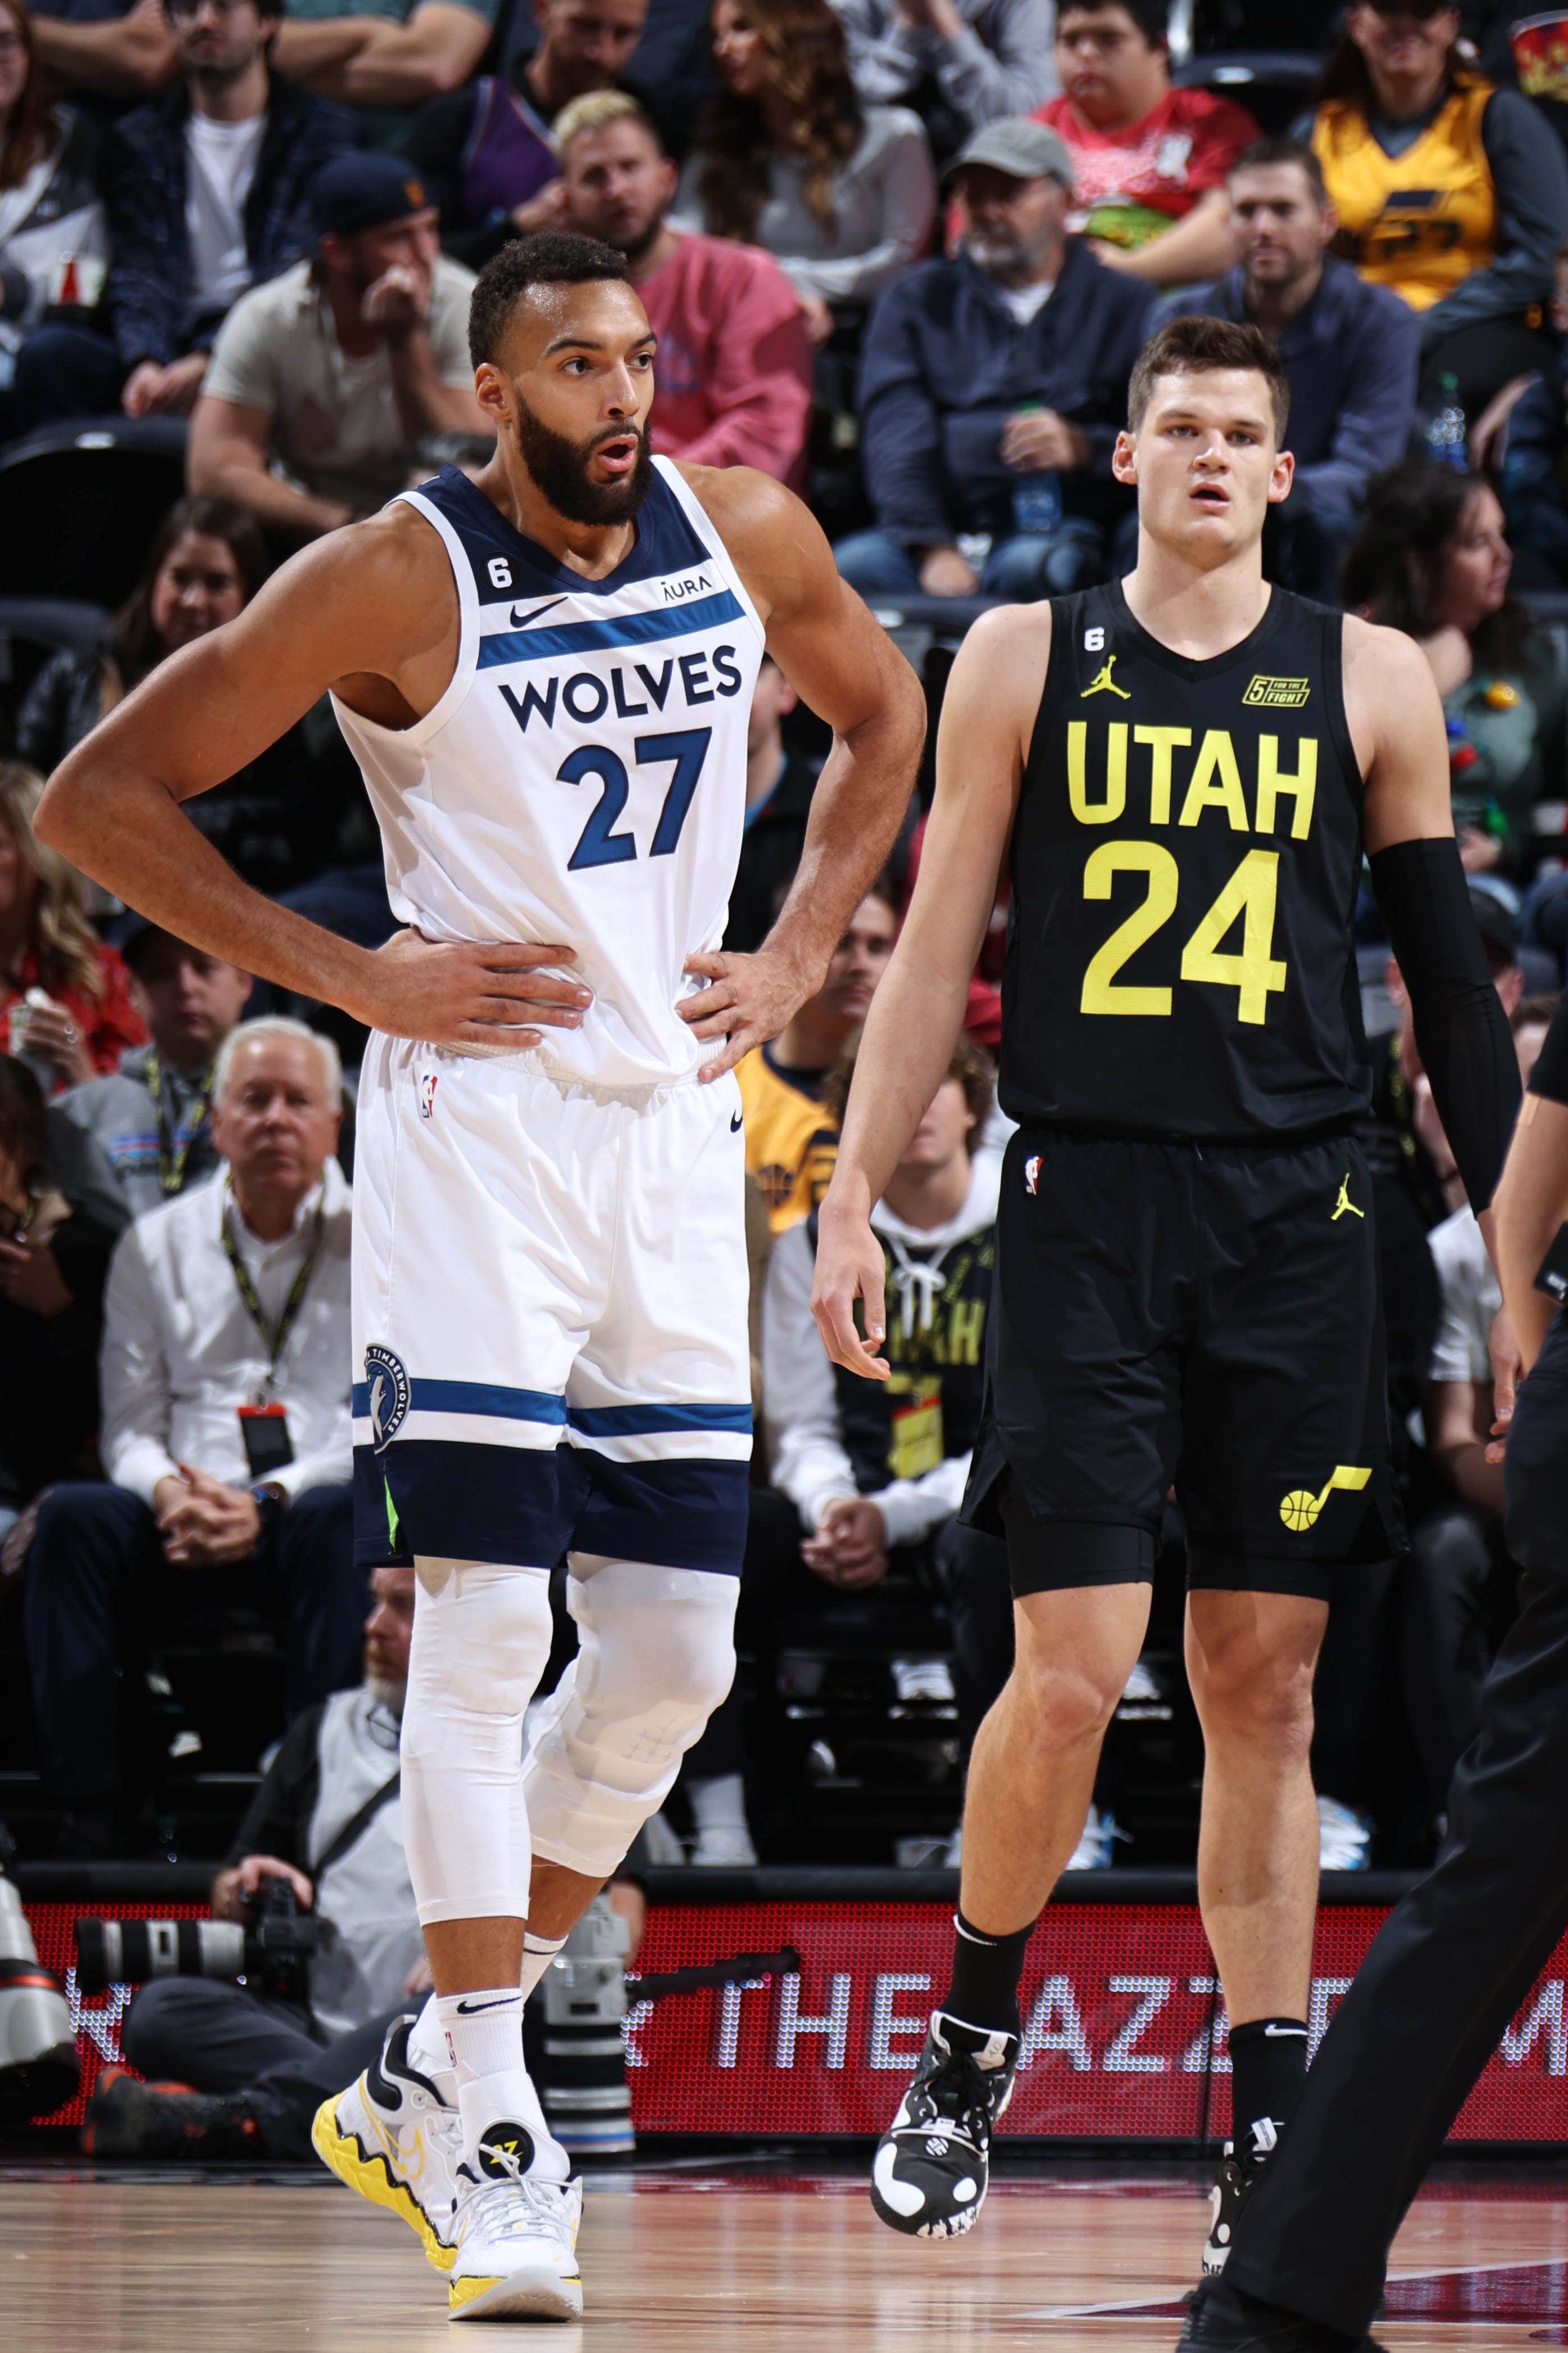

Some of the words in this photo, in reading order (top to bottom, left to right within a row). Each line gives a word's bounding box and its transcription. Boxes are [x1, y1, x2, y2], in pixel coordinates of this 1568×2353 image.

[487, 557, 512, 589] 6
[1084, 627, 1105, 651] 6
[498, 645, 742, 733] WOLVES
[1249, 680, 1267, 701] 5
[1268, 693, 1303, 703] FIGHT
[556, 726, 712, 872] 27
[1067, 721, 1318, 841] UTAH
[1080, 840, 1287, 1025] 24
[372, 1348, 407, 1433] TIMBERWOLVES
[719, 1972, 931, 2069] THE
[1015, 1974, 1234, 2071] AZZ
